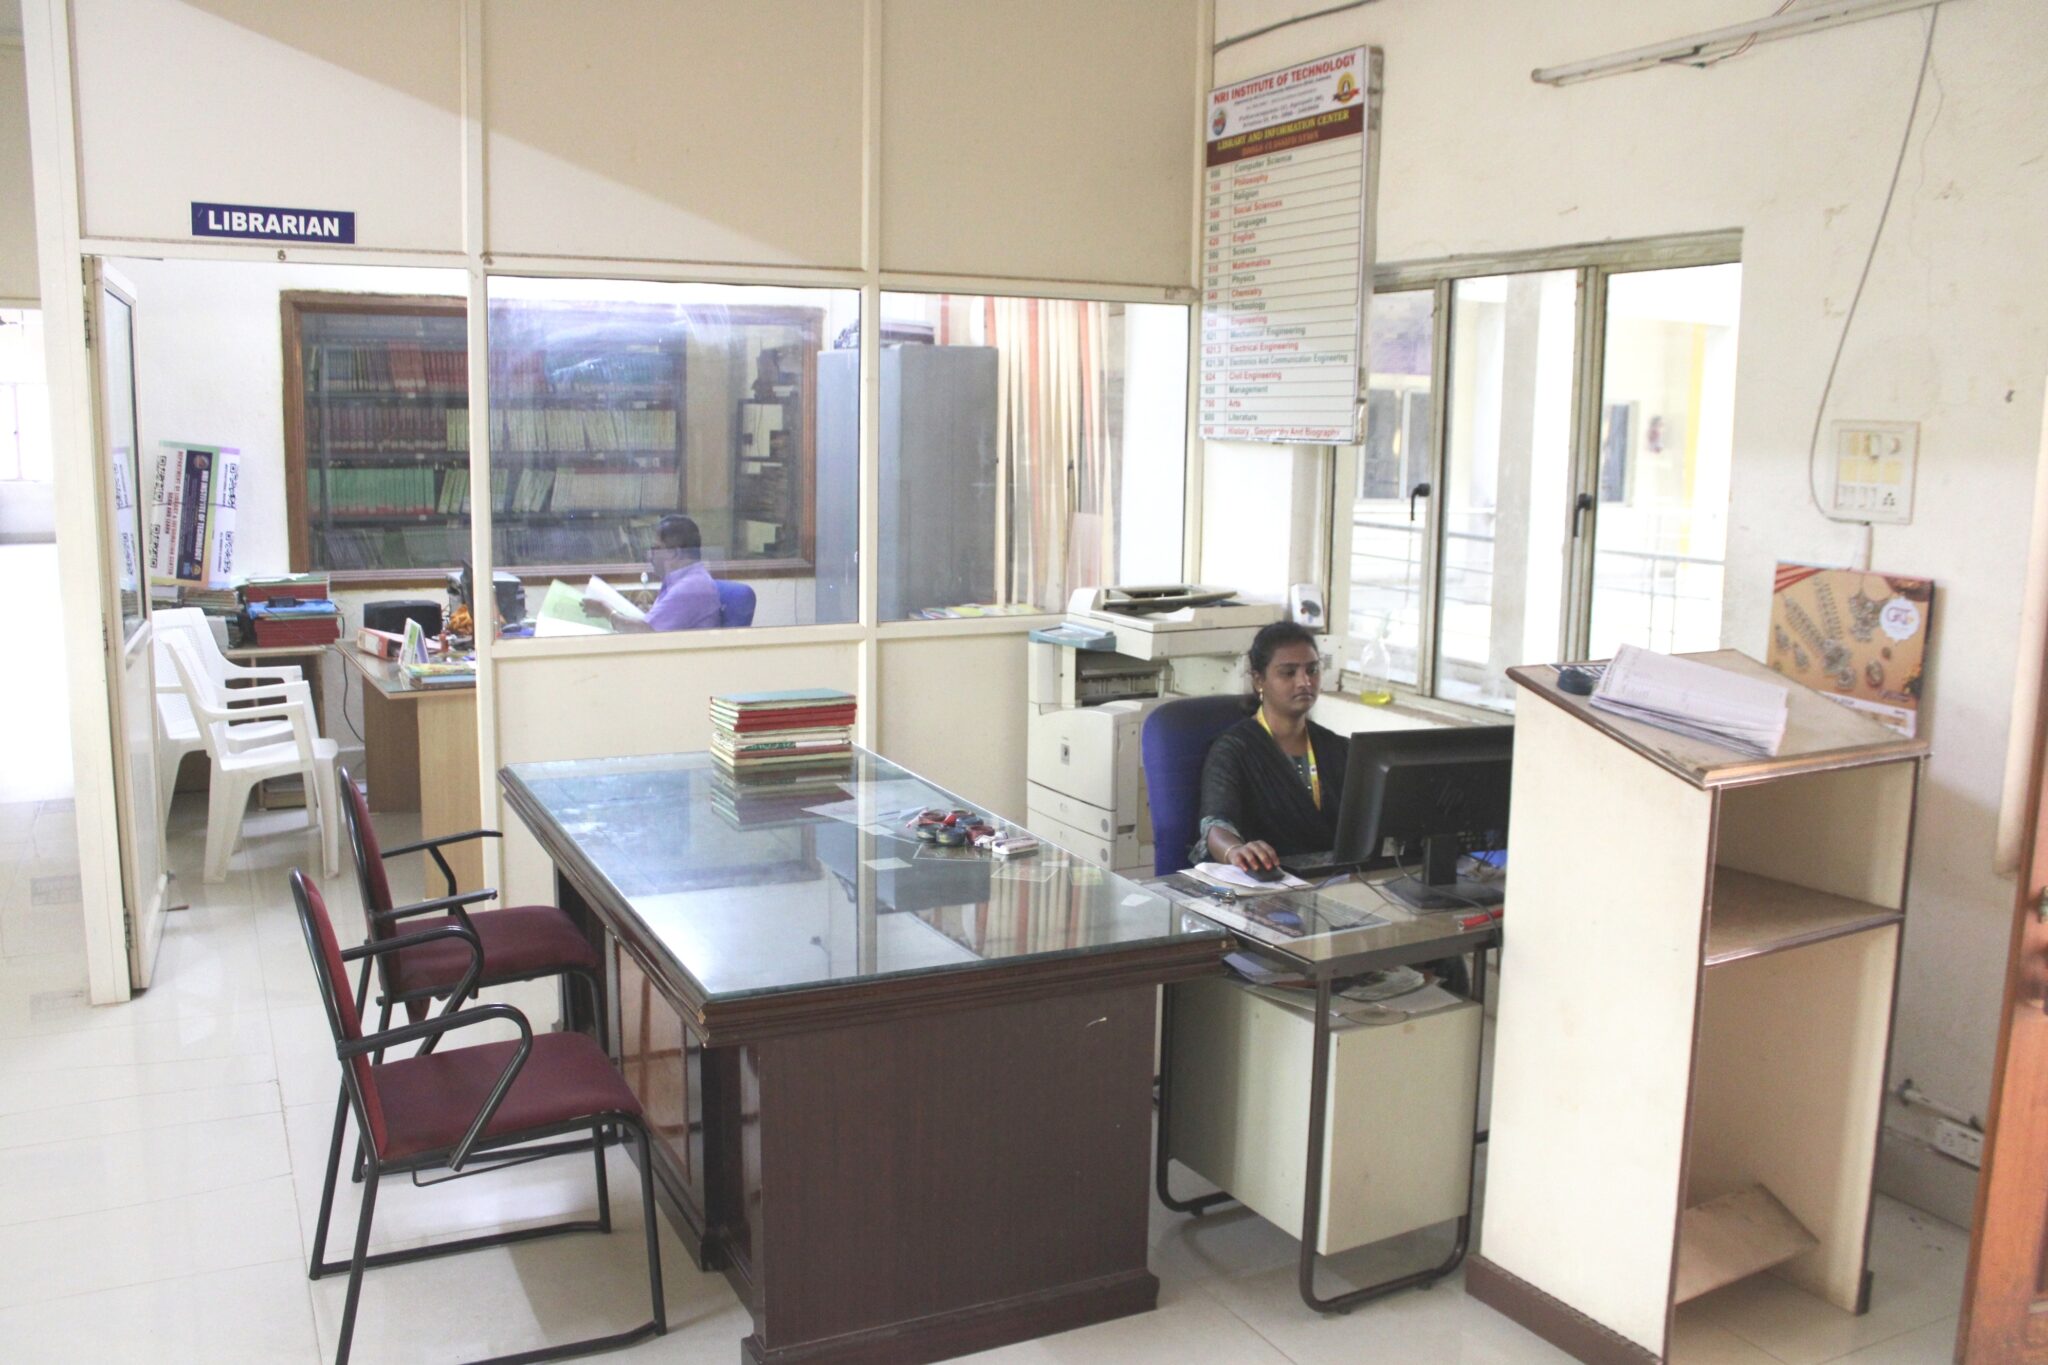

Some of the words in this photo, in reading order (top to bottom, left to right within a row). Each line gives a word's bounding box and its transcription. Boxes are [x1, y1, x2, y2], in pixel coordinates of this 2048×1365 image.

[1214, 90, 1228, 104] NRI
[1231, 77, 1273, 99] INSTITUTE
[1277, 73, 1287, 86] OF
[1291, 53, 1354, 82] TECHNOLOGY
[1217, 135, 1245, 150] LIBRARY
[1247, 130, 1262, 142] AND
[1264, 117, 1314, 138] INFORMATION
[1317, 109, 1349, 126] CENTER
[1234, 158, 1264, 173] Computer
[1266, 152, 1292, 165] Science
[1233, 172, 1268, 188] Philosophy
[1233, 188, 1258, 201] Religion
[1233, 203, 1251, 214] Social
[1254, 197, 1282, 210] Sciences
[208, 210, 339, 237] LIBRARIAN
[1233, 215, 1266, 229] Languages
[1232, 231, 1255, 243] English
[1232, 245, 1256, 256] Science
[1232, 257, 1270, 269] Mathematics
[1231, 273, 1255, 284] Physics
[1231, 286, 1262, 298] Chemistry
[1231, 300, 1265, 312] Technology
[1230, 315, 1267, 326] Engineering
[1230, 328, 1264, 337] Mechanical
[1266, 326, 1305, 337] Engineering
[1230, 343, 1257, 351] Electrical
[1260, 341, 1298, 351] Engineering
[1229, 357, 1256, 365] Electronics
[1271, 354, 1311, 363] Communication
[1313, 353, 1348, 363] Engineering
[1229, 371, 1242, 379] Civil
[1244, 370, 1281, 380] Engineering
[1229, 385, 1267, 394] Management
[1304, 427, 1339, 438] Biography
[170, 520, 178, 555] INFORMATION
[195, 523, 205, 561] TECHNOLOGY
[168, 556, 176, 575] CENTER
